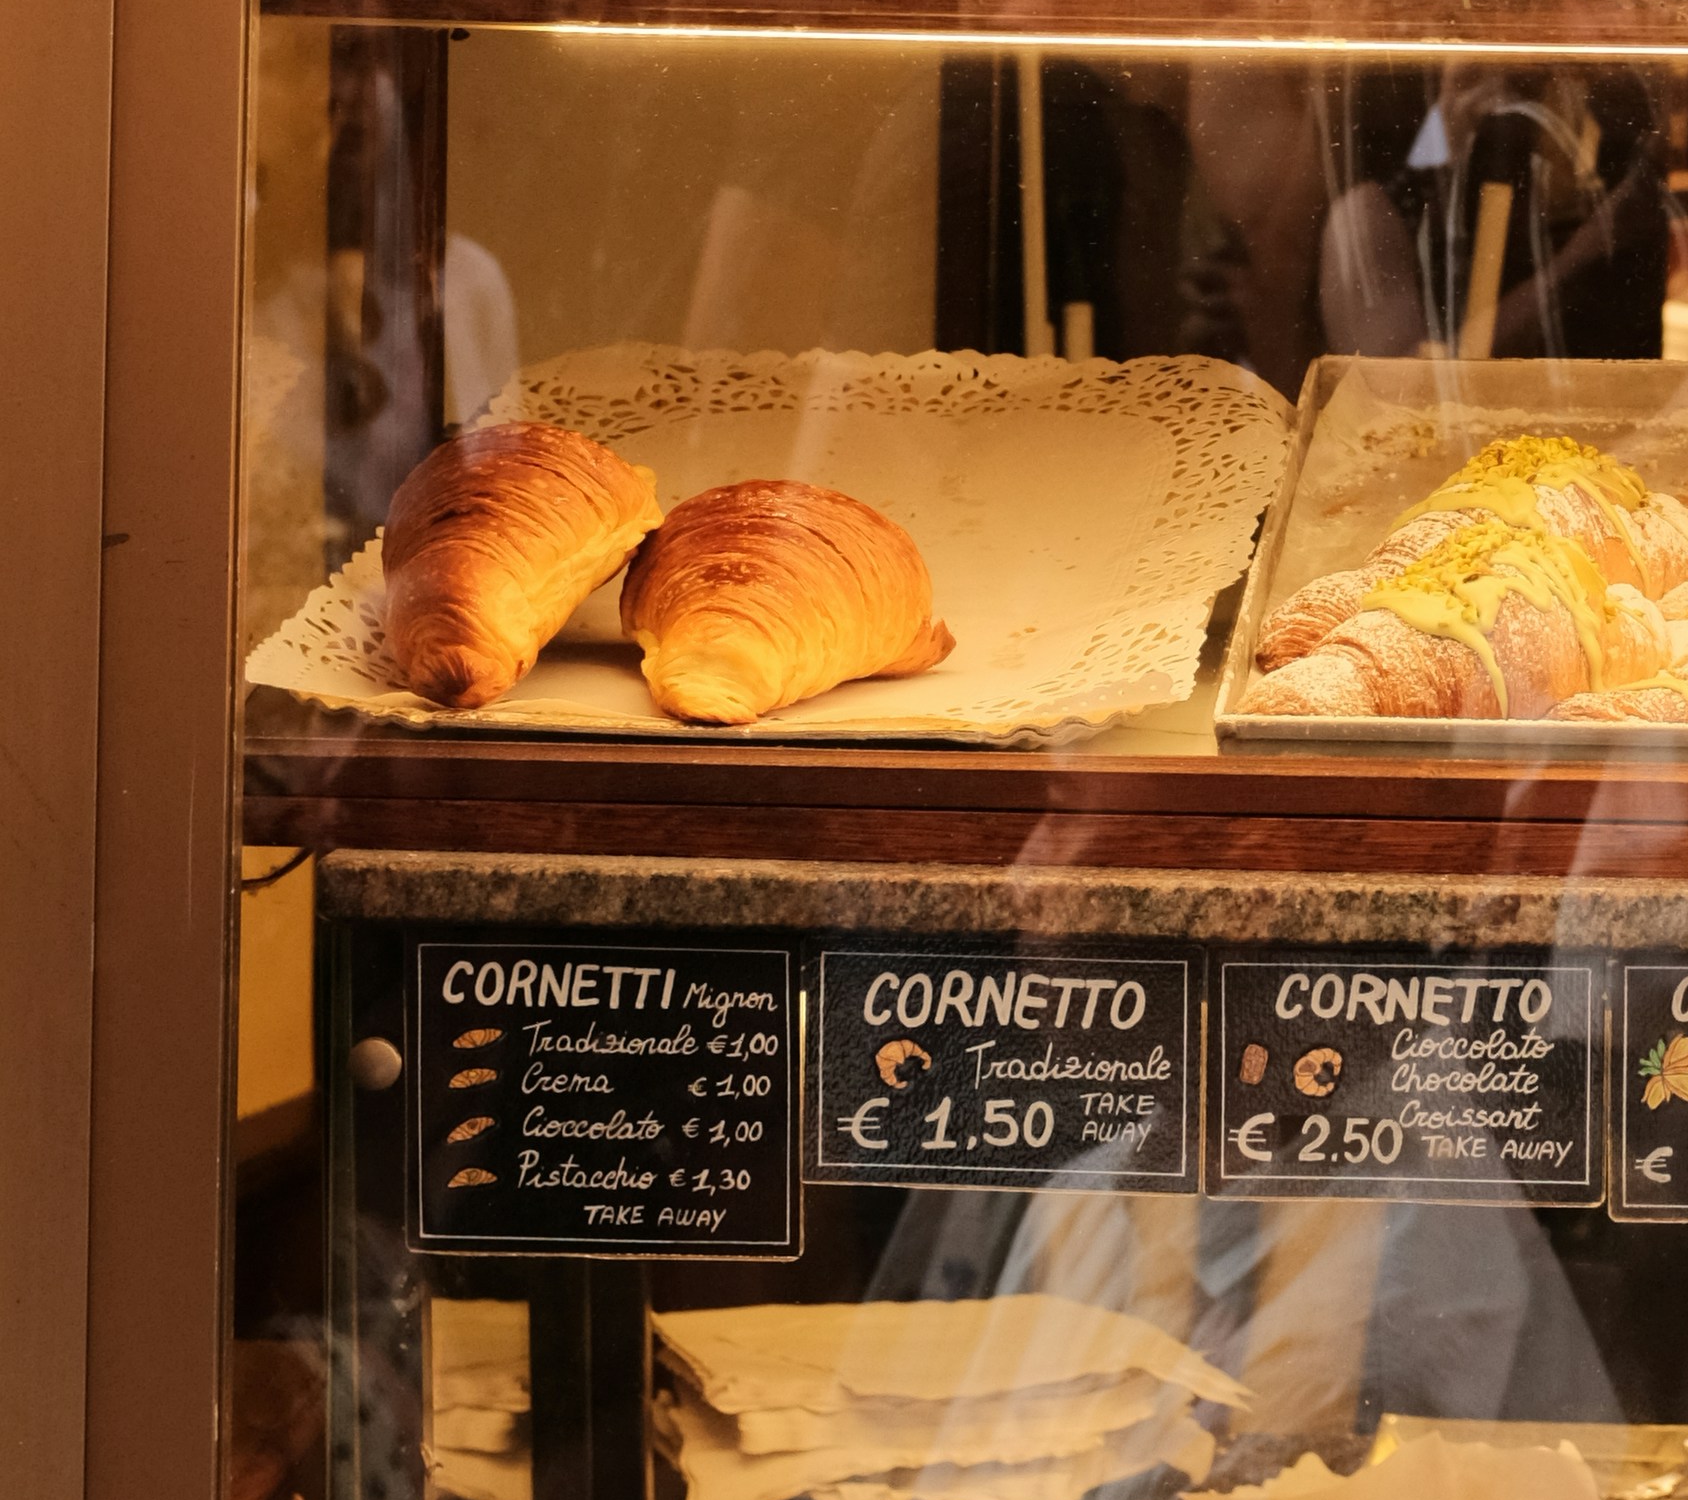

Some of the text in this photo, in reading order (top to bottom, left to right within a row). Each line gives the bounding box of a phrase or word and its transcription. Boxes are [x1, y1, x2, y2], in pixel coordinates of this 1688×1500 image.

[442, 959, 778, 1029] CORNETTI Mignon
[863, 969, 1146, 1030] CORNETTO
[1274, 973, 1554, 1028] CORNETTO
[522, 1019, 699, 1057] Tradizionale
[1390, 1022, 1555, 1066] Cioccolato
[521, 1061, 615, 1095] Crema
[965, 1039, 1172, 1090] Tradizionale
[1390, 1061, 1539, 1095] Chocolate
[522, 1105, 665, 1141] Cioccolato
[1079, 1091, 1161, 1122] TAKE
[1394, 1098, 1543, 1136] Croissant
[1079, 1115, 1158, 1158] AWAY
[1420, 1134, 1574, 1168] TAKE AWAY
[517, 1149, 658, 1191] Pistacchio
[583, 1204, 727, 1233] TAKE AWAY
